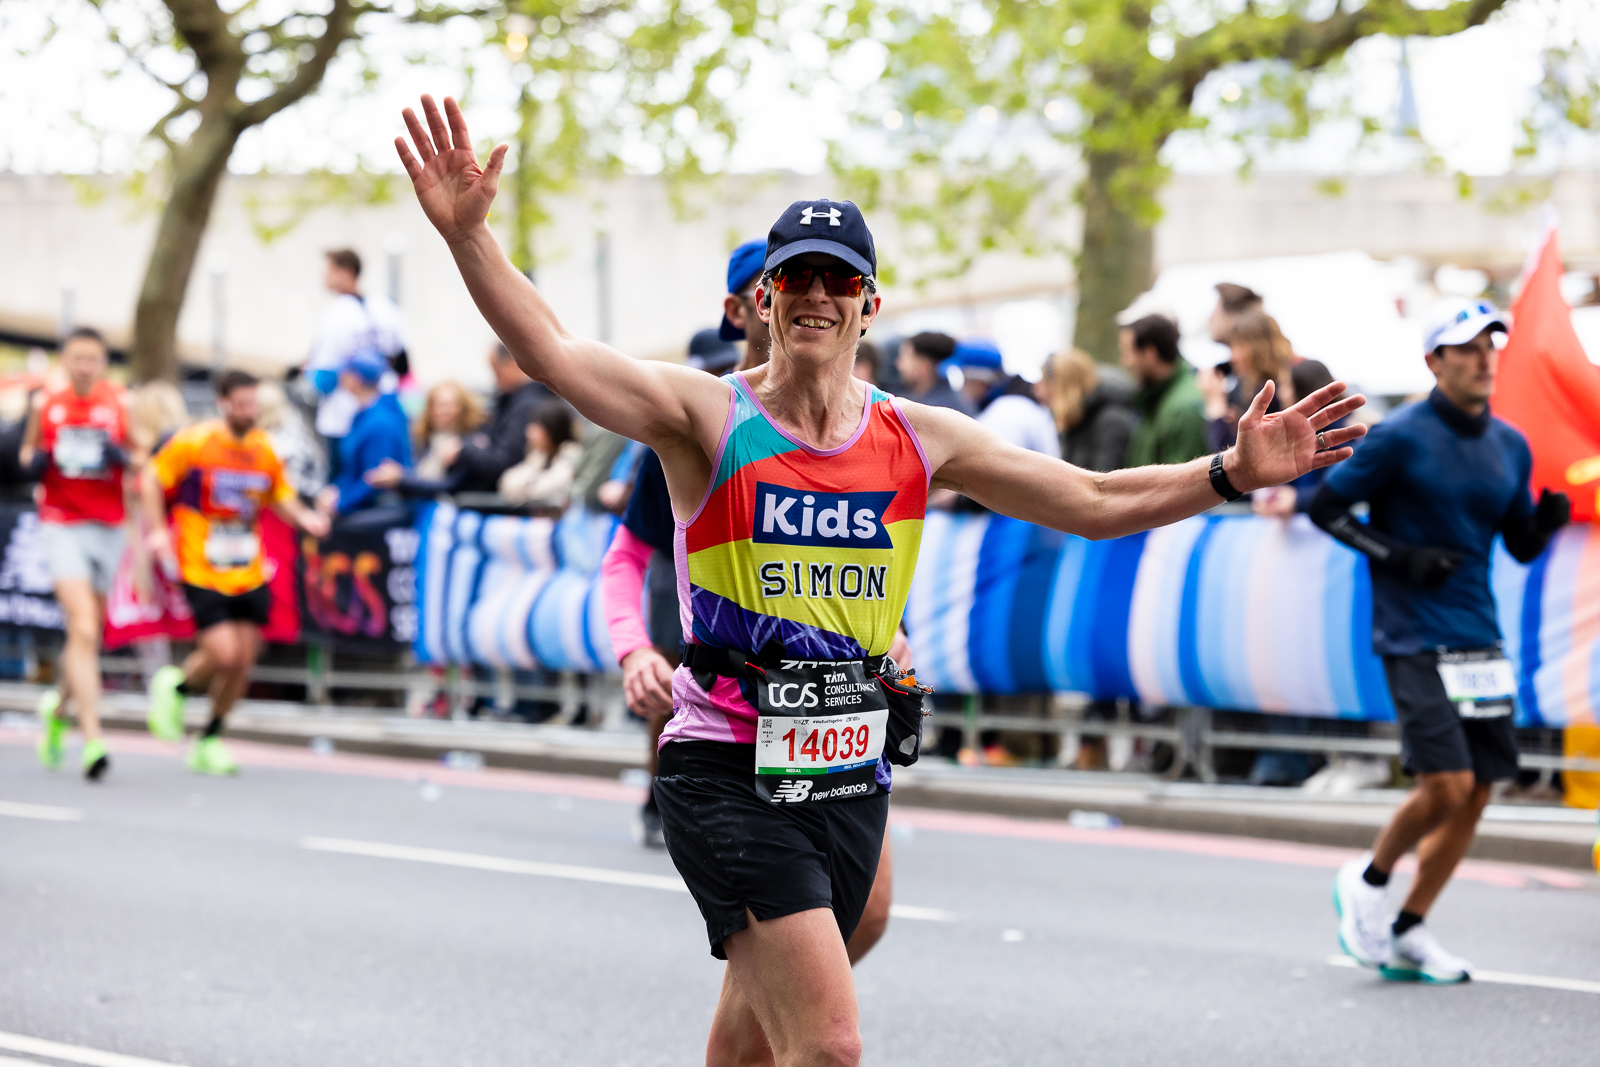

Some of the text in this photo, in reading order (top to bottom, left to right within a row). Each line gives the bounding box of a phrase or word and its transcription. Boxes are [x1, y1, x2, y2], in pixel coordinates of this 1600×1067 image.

[762, 492, 877, 539] Kids
[759, 560, 888, 600] SIMON
[823, 671, 848, 684] TATA
[768, 682, 819, 708] tcs
[824, 682, 878, 696] CONSULTANCY
[824, 694, 862, 707] SERVICES
[782, 724, 869, 762] 14039
[811, 783, 868, 801] new balance
